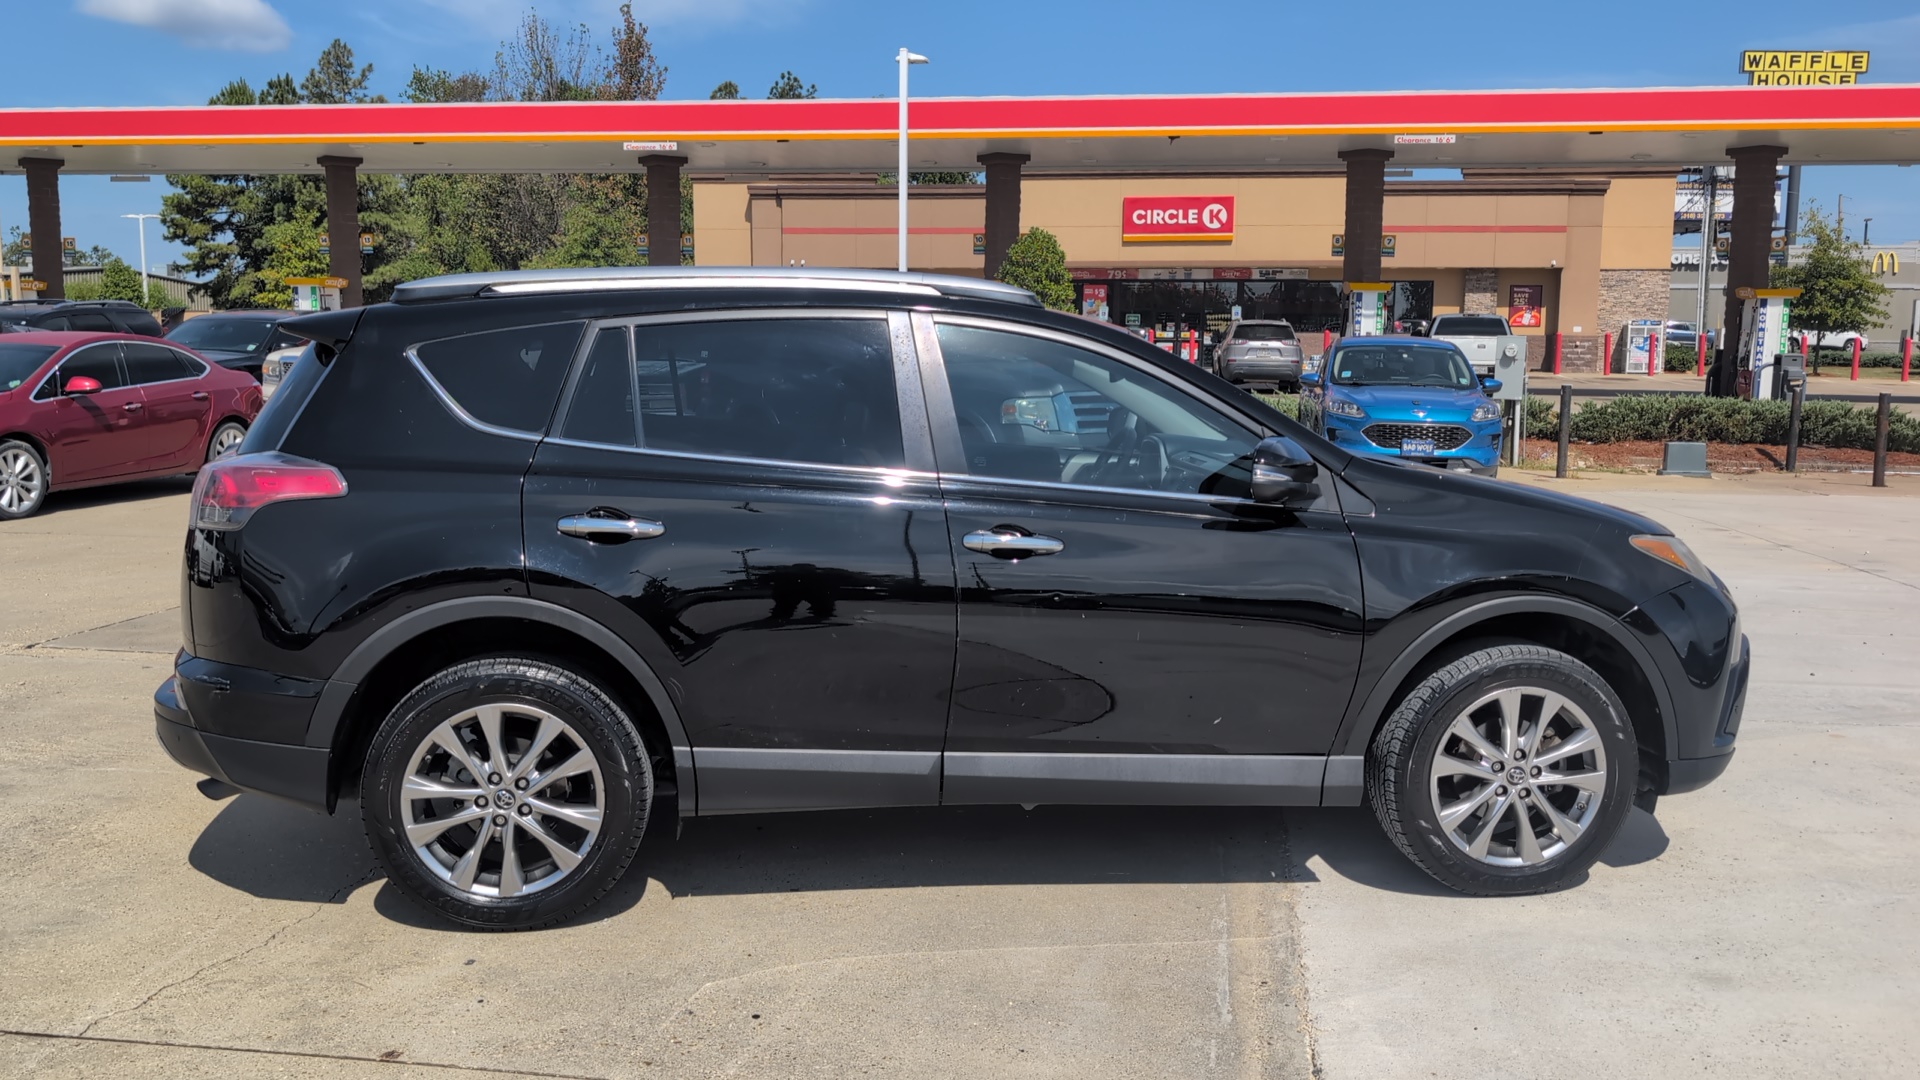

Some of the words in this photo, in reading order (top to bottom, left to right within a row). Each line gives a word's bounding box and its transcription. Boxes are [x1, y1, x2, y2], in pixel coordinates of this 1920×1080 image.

[1747, 54, 1864, 69] WAFFLE
[1757, 74, 1852, 85] HOUSE
[1132, 209, 1198, 225] CIRCLE
[1094, 288, 1105, 297] $3
[1757, 307, 1767, 329] NON
[1779, 307, 1790, 351] DIESEL
[1402, 443, 1416, 451] BAD
[1417, 444, 1433, 452] WOLF
